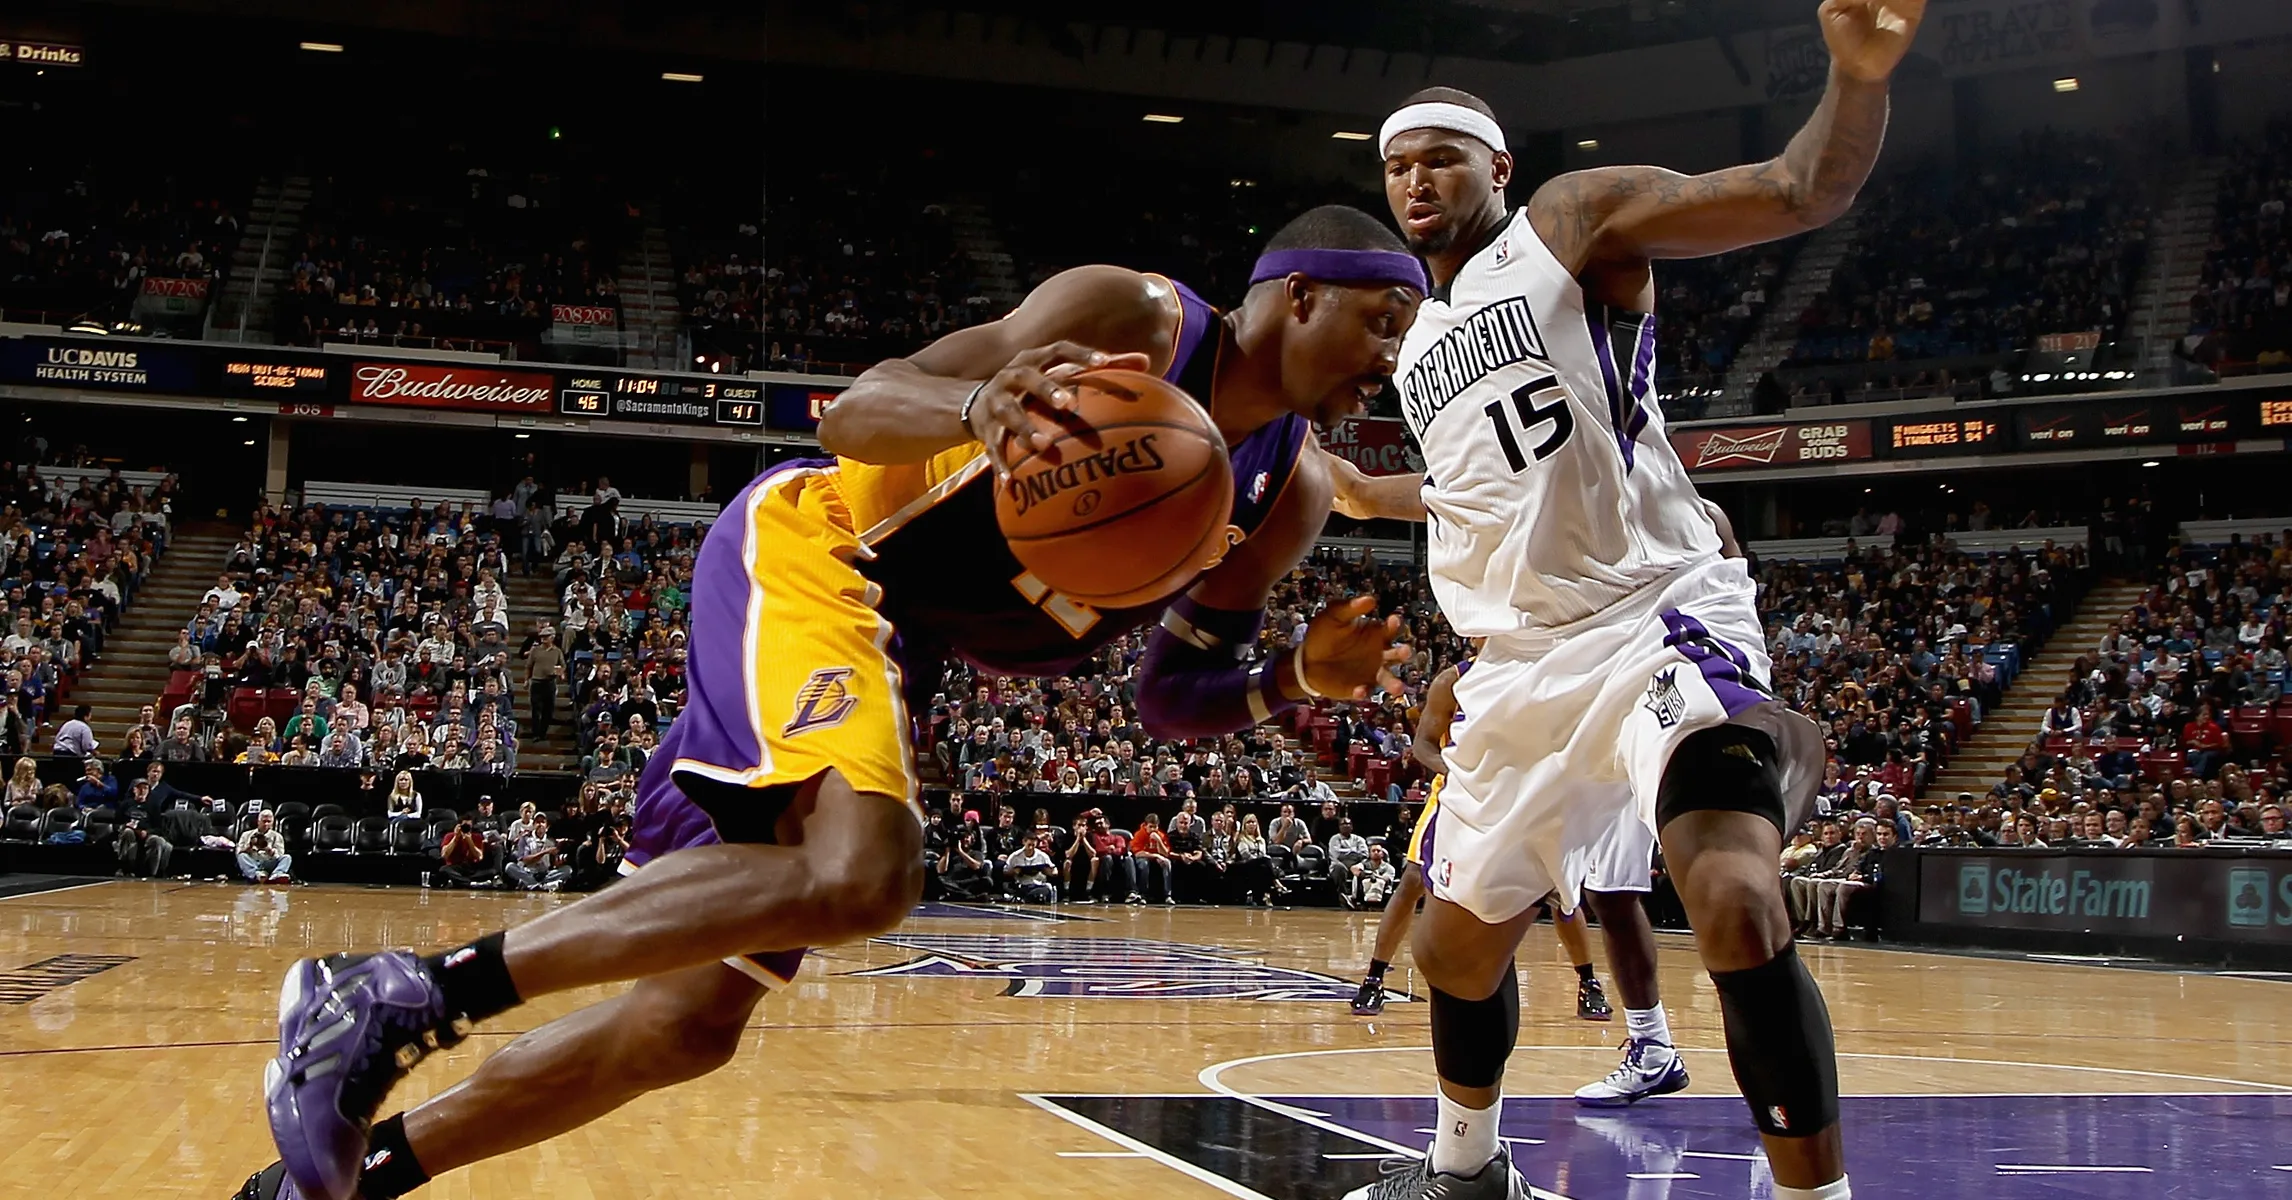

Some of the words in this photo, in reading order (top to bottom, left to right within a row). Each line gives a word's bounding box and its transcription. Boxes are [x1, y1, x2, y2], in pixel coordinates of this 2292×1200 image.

[17, 45, 80, 63] Drinks
[146, 279, 175, 296] 207
[553, 307, 582, 323] 208
[584, 308, 614, 325] 209
[1402, 295, 1549, 439] SACRAMENTO
[36, 367, 90, 381] HEALTH
[93, 370, 148, 385] SYSTEM
[253, 376, 296, 388] SCORES
[570, 378, 602, 390] HOME
[356, 366, 550, 404] Budweiser
[615, 378, 659, 395] 11:04
[703, 384, 717, 398] 3
[723, 388, 758, 400] GUEST
[292, 403, 321, 416] 108
[616, 399, 709, 418] @SacramentoKings
[732, 404, 754, 420] 41
[1484, 374, 1576, 476] 15
[1798, 425, 1848, 440] GRAB
[1903, 422, 1958, 436] NUGGETS
[1985, 424, 1997, 435] F
[1697, 438, 1784, 457] Budweiser
[1807, 437, 1840, 447] SOME
[1903, 433, 1959, 446] TWOLVES
[1800, 445, 1848, 460] BUDS
[1011, 433, 1164, 517] SPALDING
